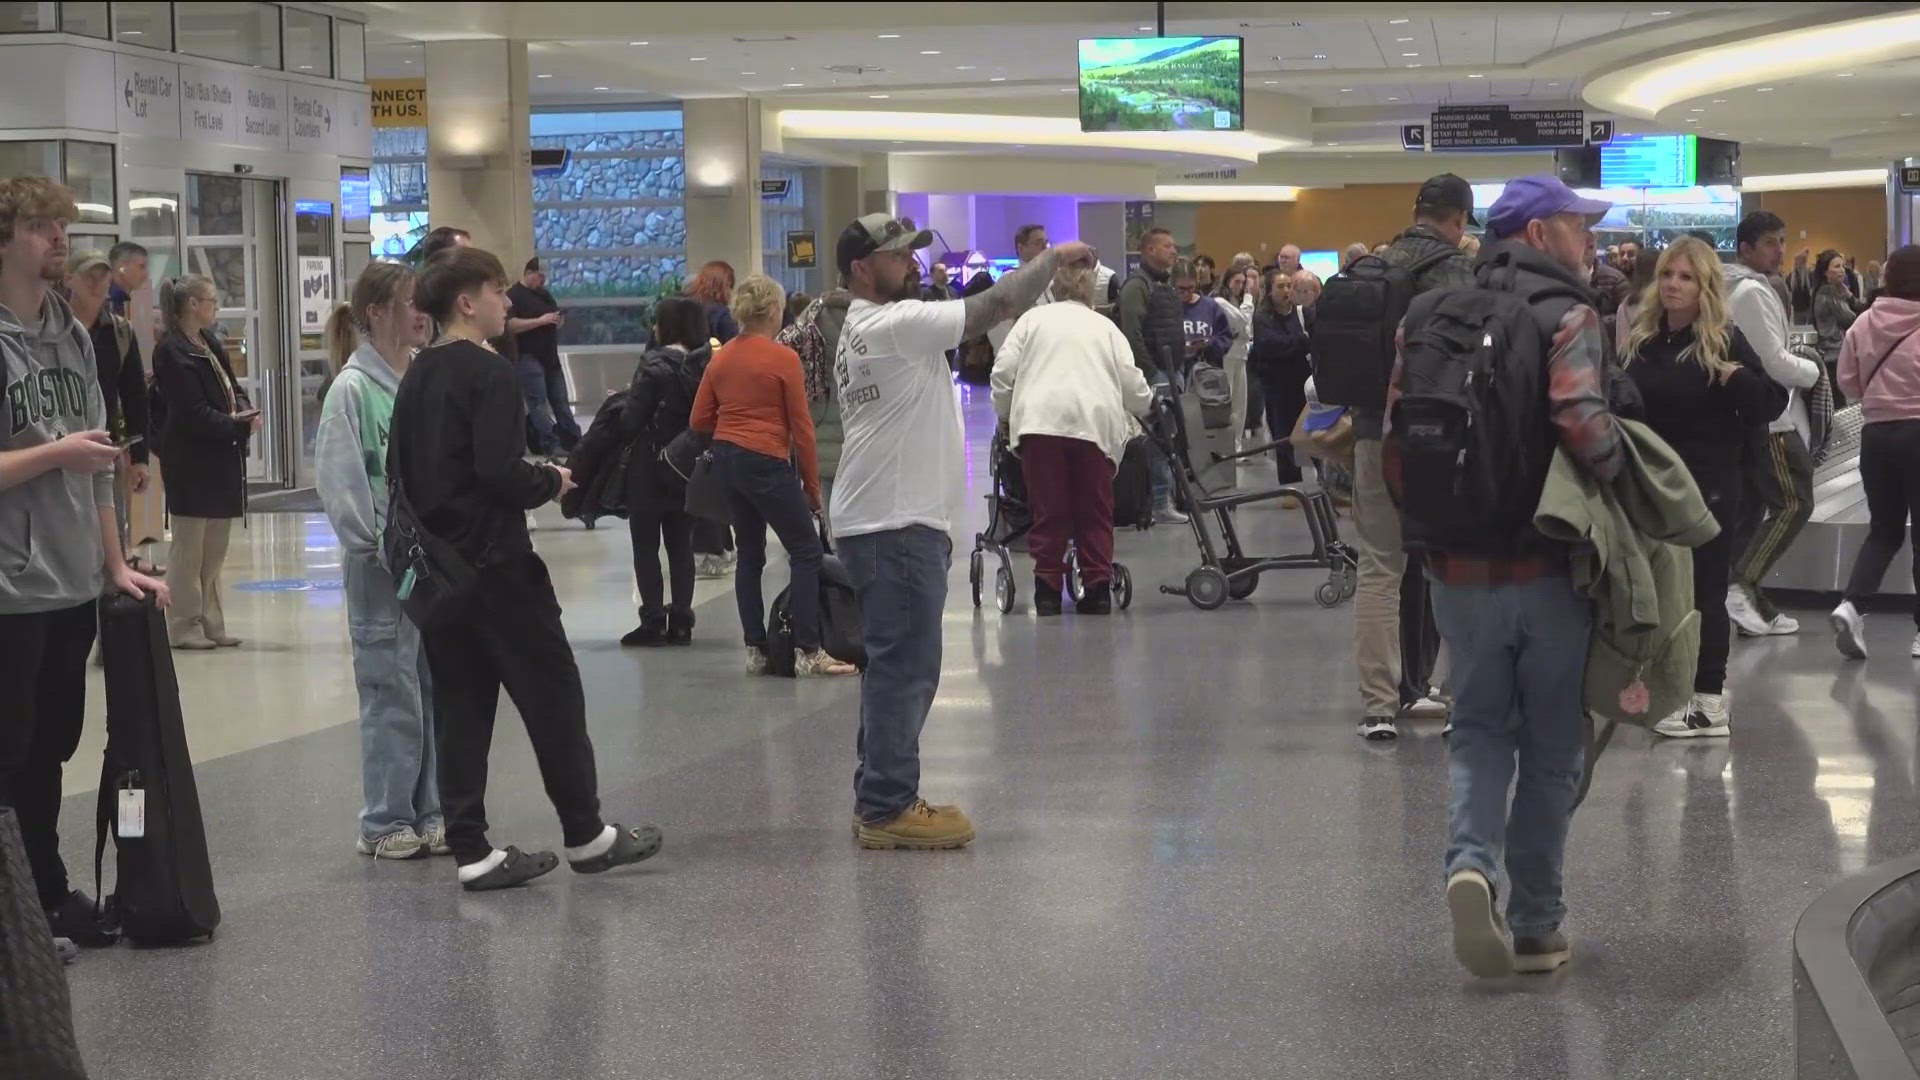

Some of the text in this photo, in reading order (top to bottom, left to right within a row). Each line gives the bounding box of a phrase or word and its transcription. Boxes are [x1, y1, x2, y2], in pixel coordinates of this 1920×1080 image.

[135, 72, 172, 97] Rental Car
[371, 89, 426, 101] NNECT
[135, 96, 147, 118] Lot
[294, 95, 323, 118] Rental Car
[371, 104, 422, 117] TH US.
[194, 109, 223, 131] First Level
[246, 116, 265, 135] Second
[850, 333, 868, 355] UP
[846, 384, 880, 405] SPEED
